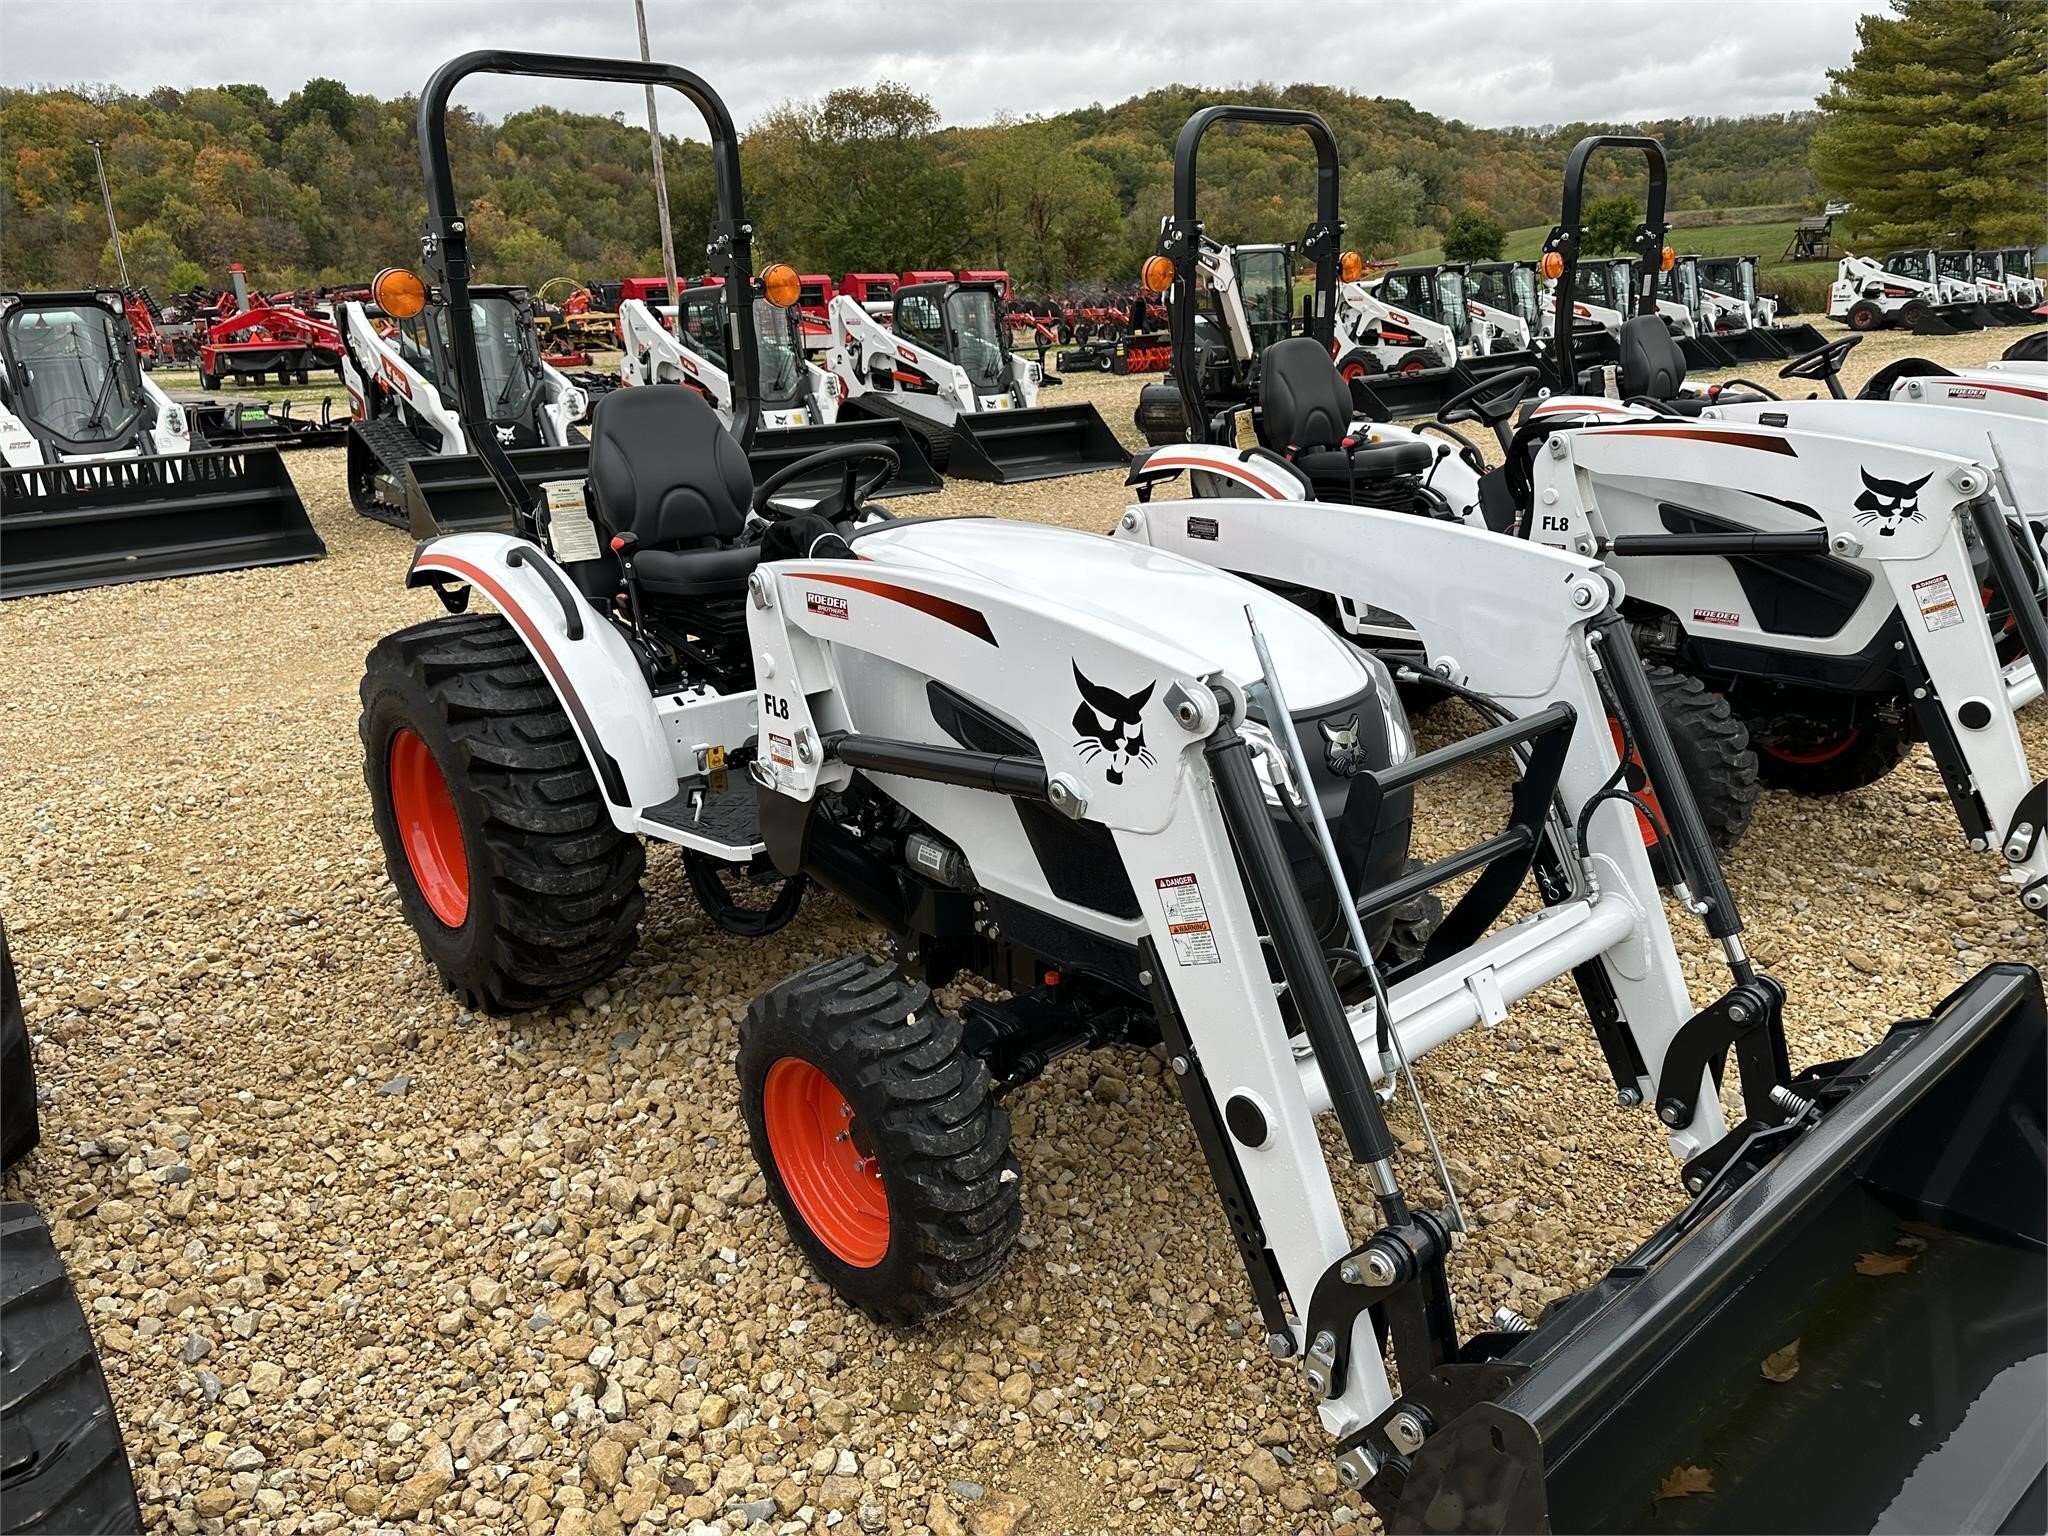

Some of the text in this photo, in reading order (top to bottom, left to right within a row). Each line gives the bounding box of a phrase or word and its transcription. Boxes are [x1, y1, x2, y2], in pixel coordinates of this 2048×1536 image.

[1542, 516, 1569, 531] FL8
[807, 593, 847, 610] ROEDER
[817, 604, 845, 616] BROTHERS
[1694, 609, 1739, 621] ROEDER
[764, 693, 789, 720] FL8
[1166, 876, 1194, 887] DANGER
[1177, 923, 1207, 932] WARNING
